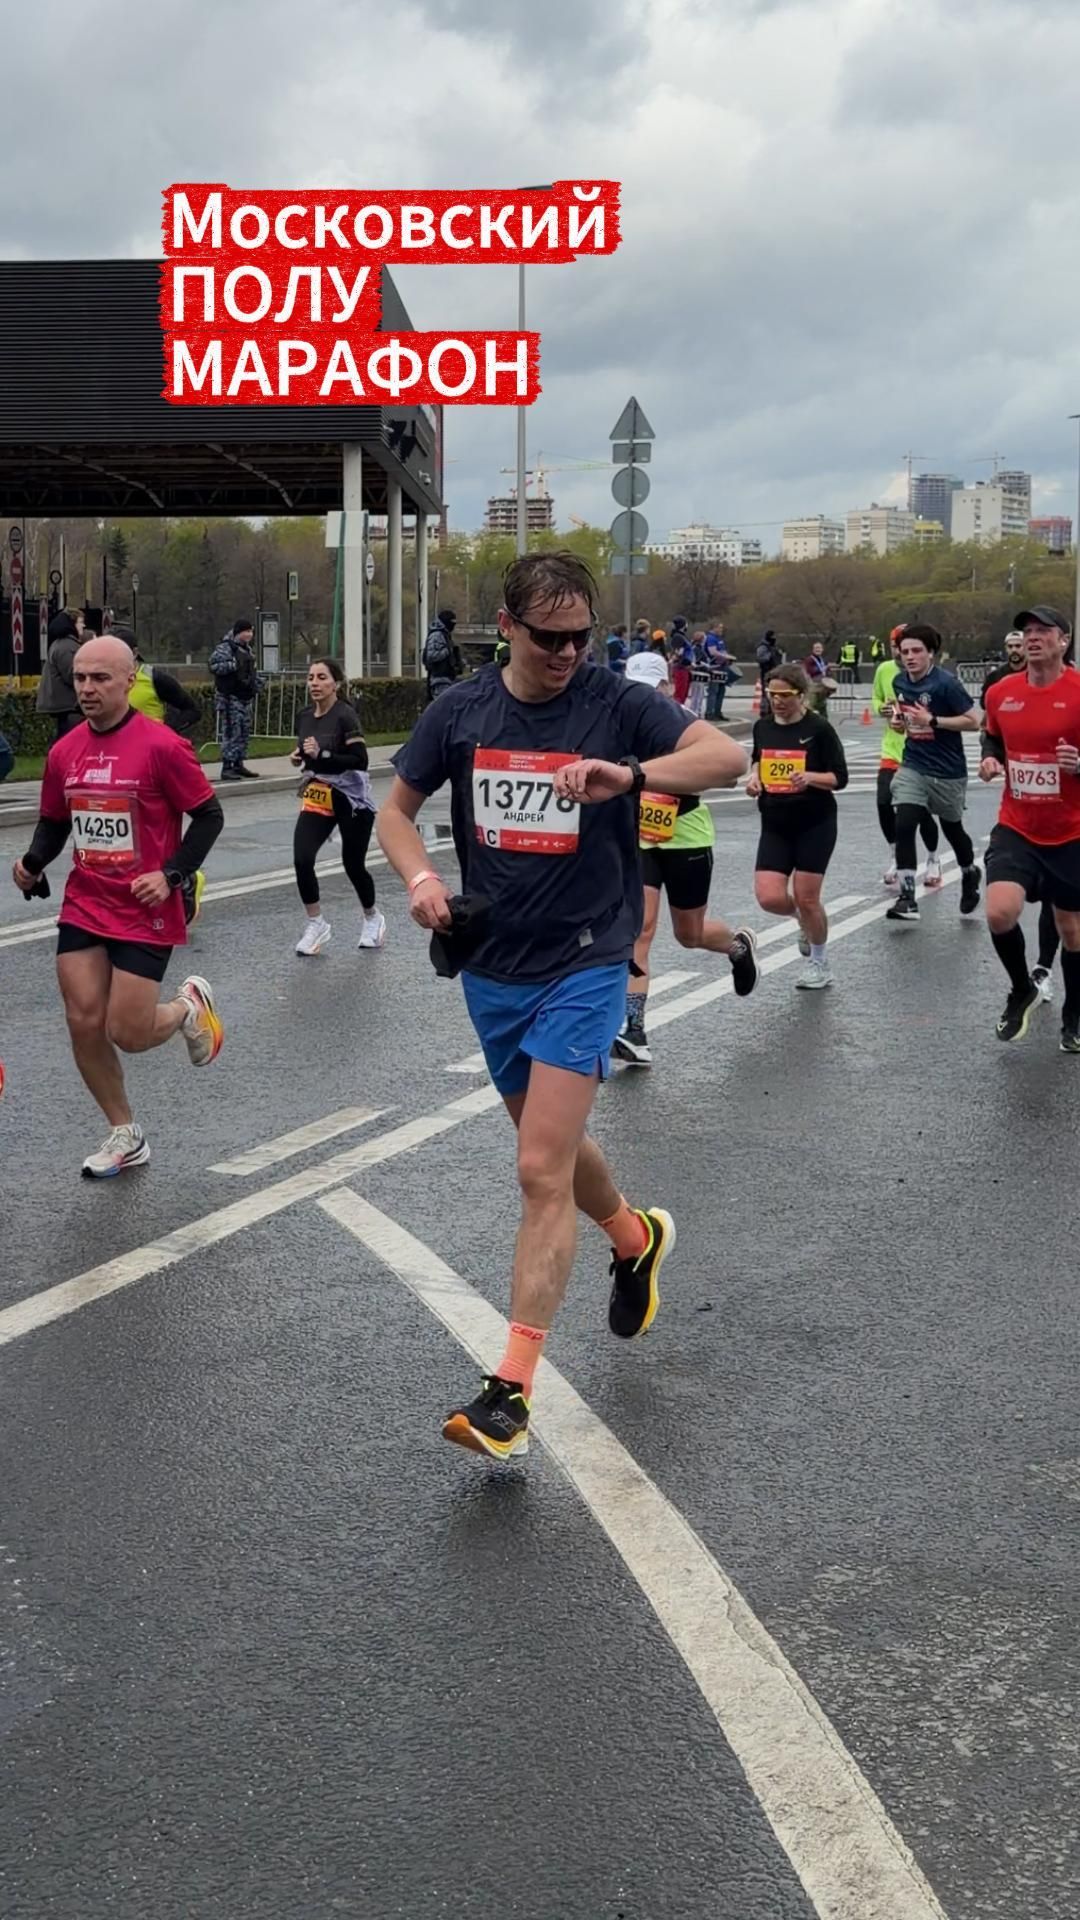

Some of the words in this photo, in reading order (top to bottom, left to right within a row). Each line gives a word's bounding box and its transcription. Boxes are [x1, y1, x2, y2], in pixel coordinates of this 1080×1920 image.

[1010, 767, 1057, 786] 18763
[503, 811, 545, 824] АНДРЕЙ
[73, 815, 129, 838] 14250
[511, 1325, 544, 1340] cep
